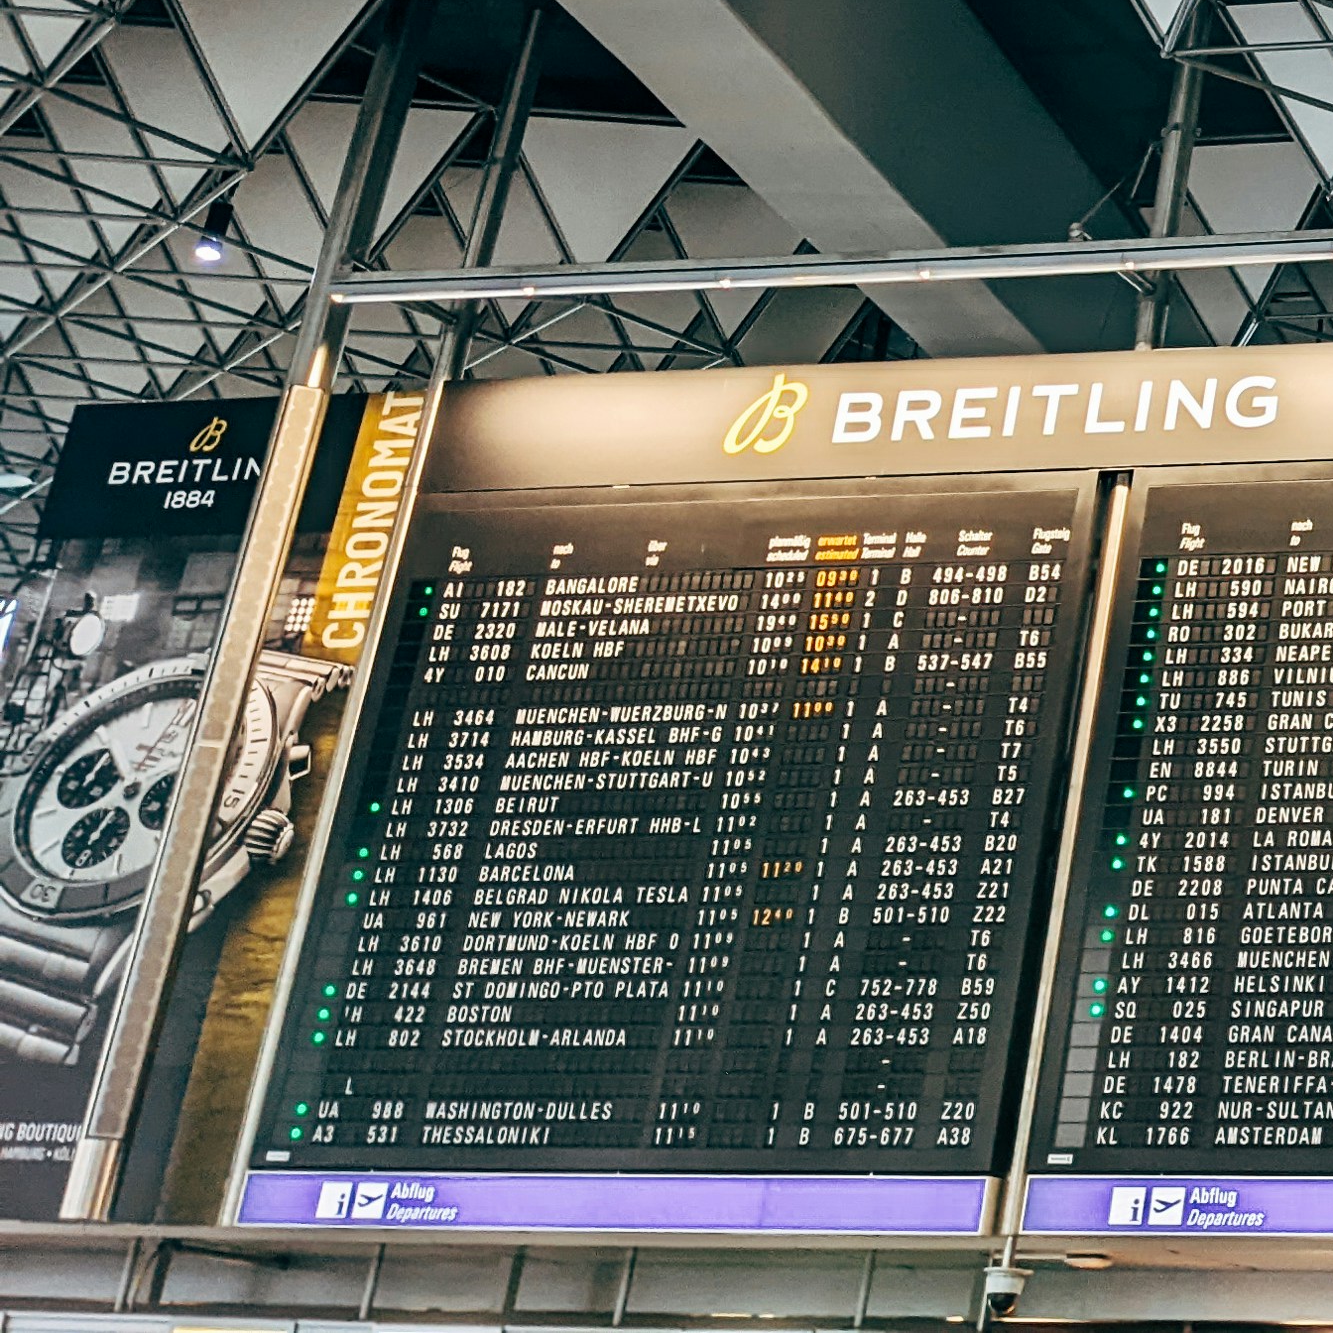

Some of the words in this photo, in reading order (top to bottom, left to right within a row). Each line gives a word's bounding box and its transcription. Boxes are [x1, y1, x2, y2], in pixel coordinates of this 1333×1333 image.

[832, 375, 1278, 443] BREITLING
[108, 457, 261, 485] BREITLIN
[163, 490, 215, 509] 1884
[322, 391, 424, 649] CHRONOMAT
[1182, 523, 1200, 537] Flug
[1180, 536, 1205, 551] Flight
[443, 582, 463, 598] AI
[497, 580, 526, 597] 182
[545, 576, 639, 596] BANGALORE
[932, 565, 1007, 584] 494-498
[1029, 563, 1061, 581] B54
[1175, 581, 1197, 598] LH
[1229, 579, 1262, 597] 590
[1281, 600, 1327, 618] PORT
[530, 642, 584, 660] KOELN
[593, 640, 625, 658] HBF
[526, 663, 590, 681] CANCUN
[511, 728, 655, 746] HAMBURG-KASSEL
[495, 796, 559, 814] BEIRUT
[893, 788, 969, 806] 263-453
[1255, 806, 1324, 824] DENVER
[479, 864, 574, 882] BARCELONA
[473, 888, 549, 906] BELGRAD
[559, 887, 623, 904] NIKOLA
[637, 886, 688, 904] TESLA
[1234, 974, 1325, 993] HELSINKI
[1231, 1000, 1324, 1018] SINGAPUR
[441, 1028, 626, 1047] STOCKHOLM-ARLANDA
[318, 1101, 339, 1118] UA
[371, 1102, 403, 1119] 988
[425, 1102, 613, 1120] WASHINGTON-DULLES
[1100, 1101, 1123, 1120] KC
[1159, 1101, 1193, 1120] 922
[423, 1126, 550, 1144] THESSALONIKI
[937, 1126, 971, 1146] A38
[1215, 1126, 1323, 1145] AMSTERDAM
[391, 1182, 435, 1201] Abflug
[1190, 1187, 1237, 1207] Abflug
[386, 1202, 458, 1222] Departures
[1187, 1209, 1264, 1228] Departures
